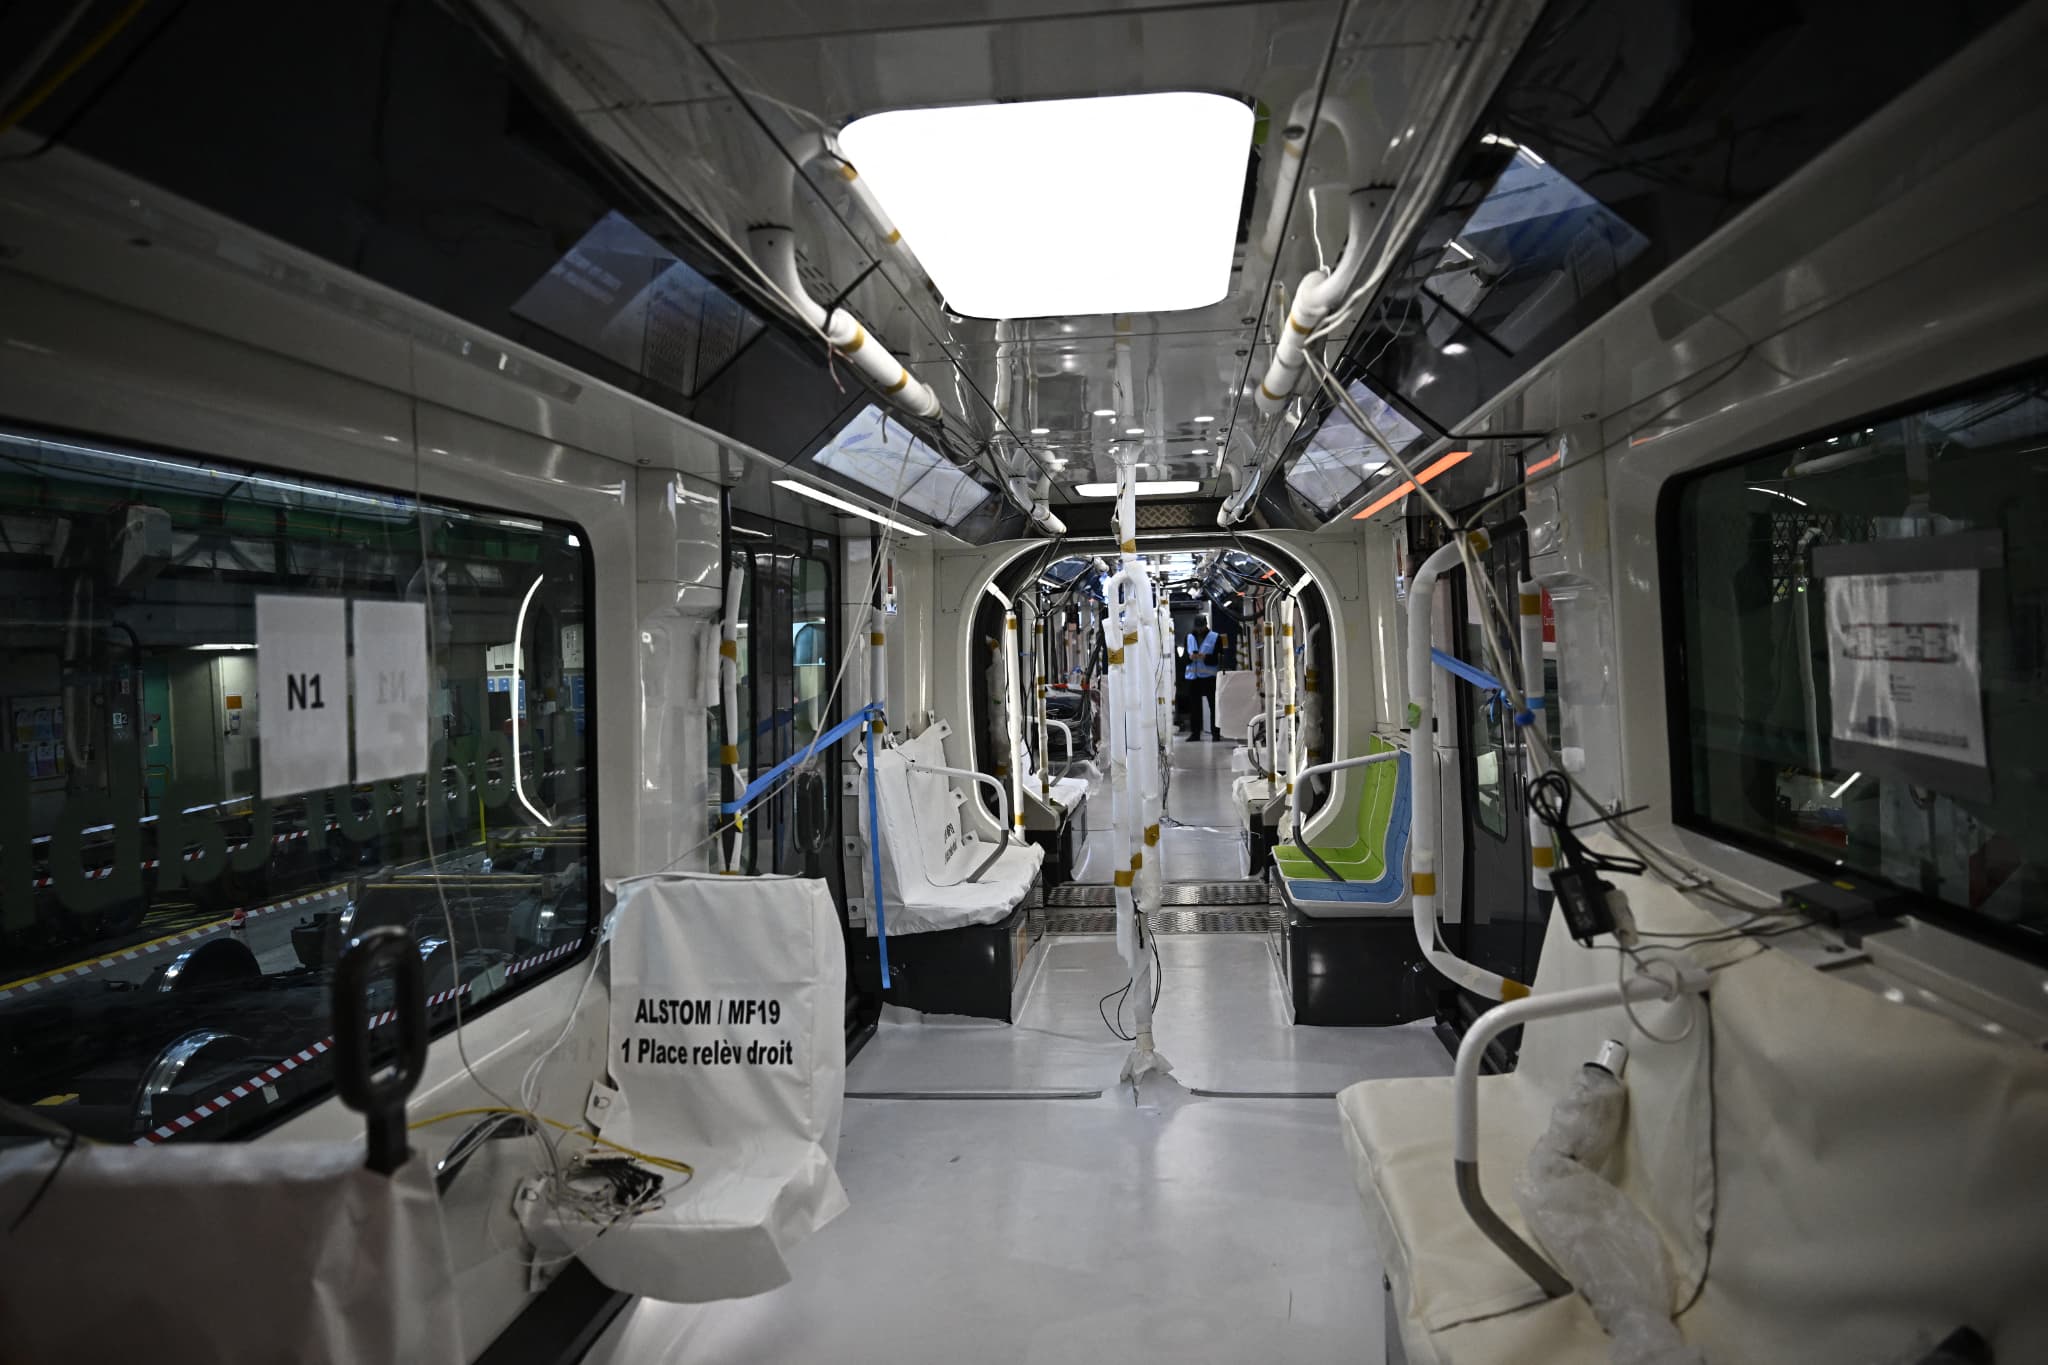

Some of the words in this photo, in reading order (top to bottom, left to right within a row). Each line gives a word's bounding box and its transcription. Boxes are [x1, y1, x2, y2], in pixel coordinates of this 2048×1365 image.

[287, 673, 325, 711] N1
[634, 998, 712, 1025] ALSTOM
[716, 999, 723, 1025] /
[728, 999, 781, 1025] MF19
[621, 1037, 631, 1064] 1
[637, 1037, 688, 1065] Place
[692, 1038, 742, 1066] relèv
[746, 1039, 793, 1066] droit
